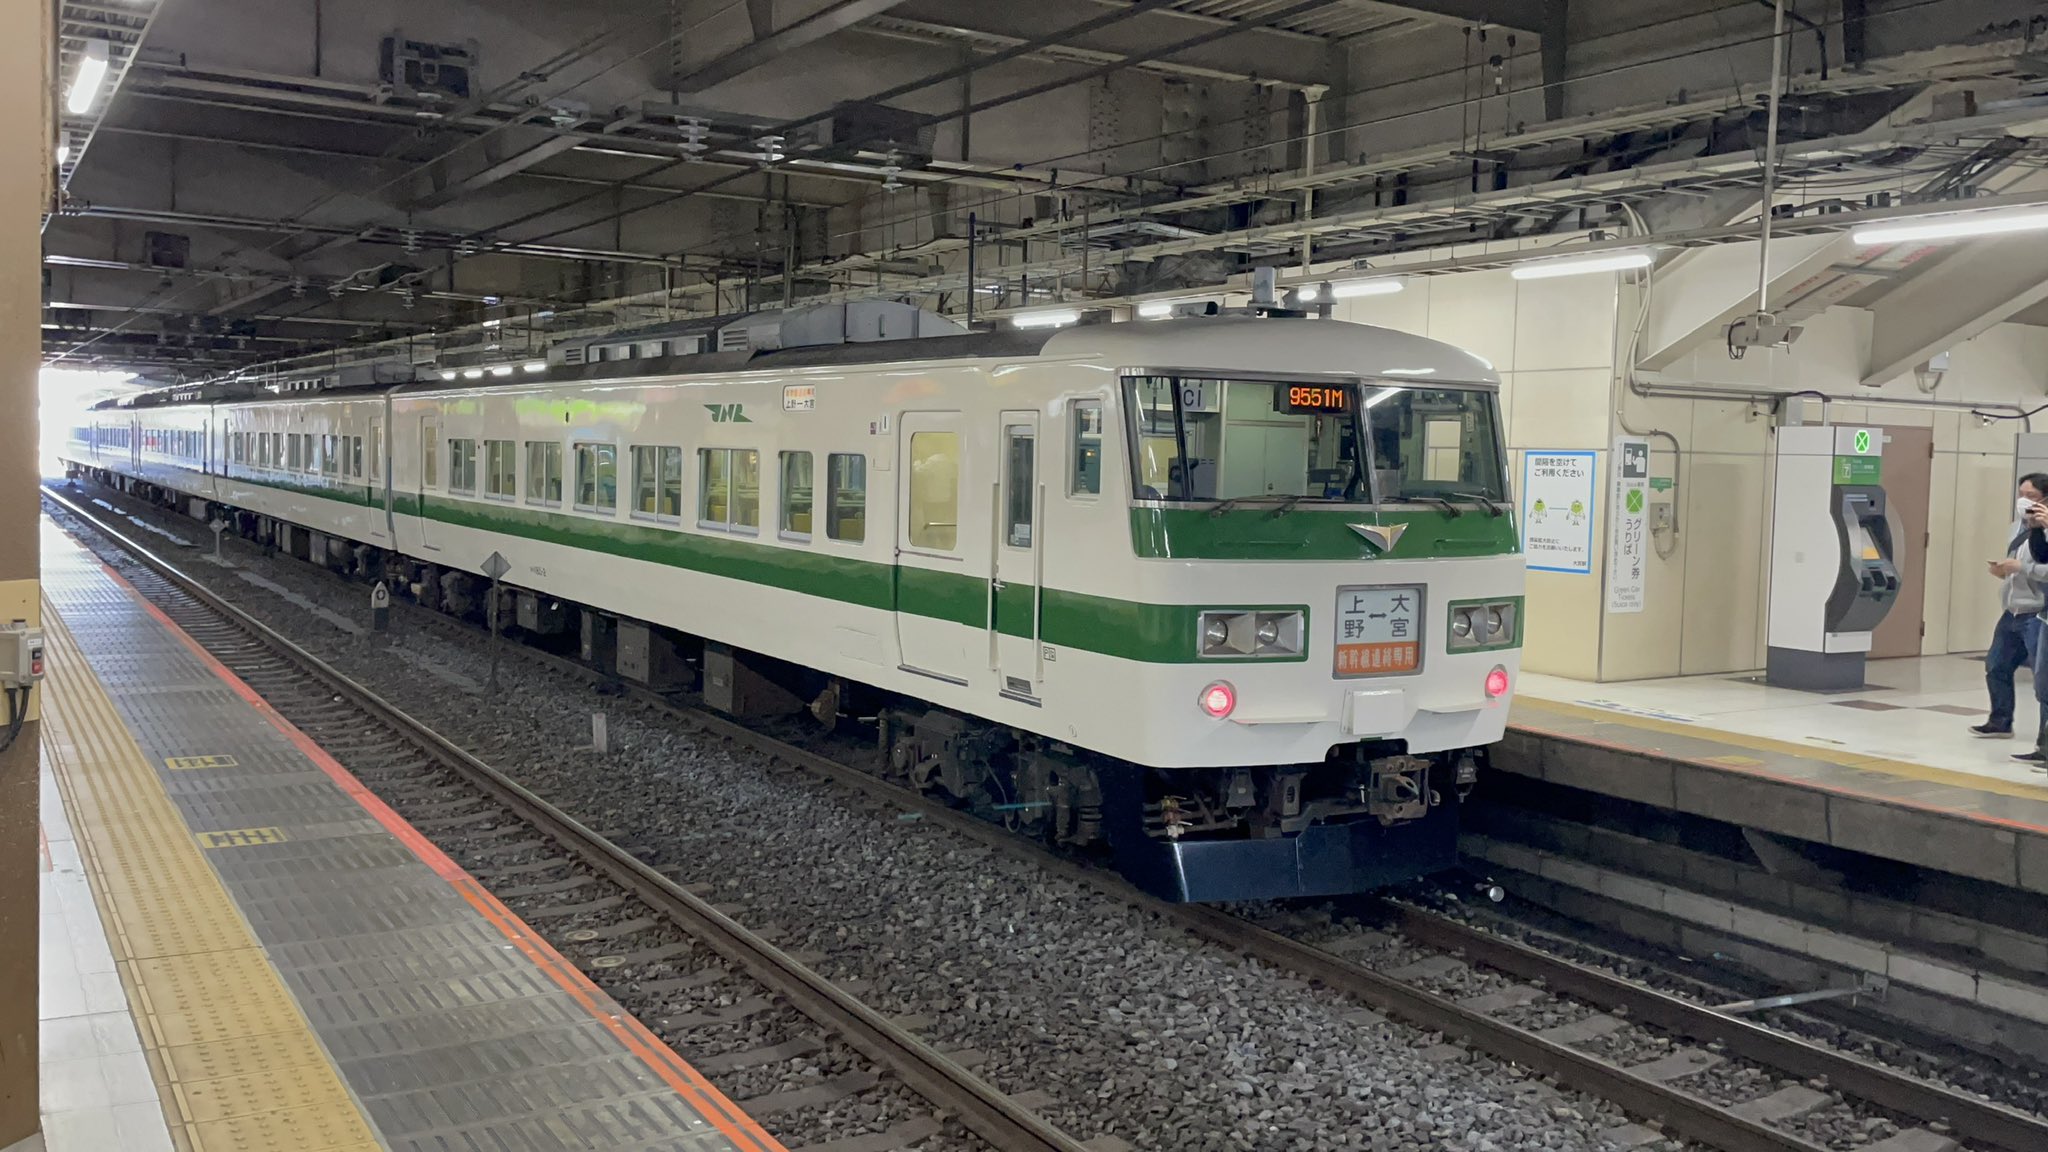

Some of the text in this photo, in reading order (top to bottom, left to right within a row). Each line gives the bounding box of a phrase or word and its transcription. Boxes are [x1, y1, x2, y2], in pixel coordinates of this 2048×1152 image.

[1289, 386, 1343, 408] 9551M
[703, 403, 753, 423] JNR
[1534, 457, 1577, 468] 間隔を空けて
[1534, 468, 1584, 478] ご利用ください
[1623, 518, 1633, 555] うりば
[1631, 518, 1643, 579] グリーン券
[1344, 595, 1365, 639] 上野
[1390, 594, 1410, 638] 大宮
